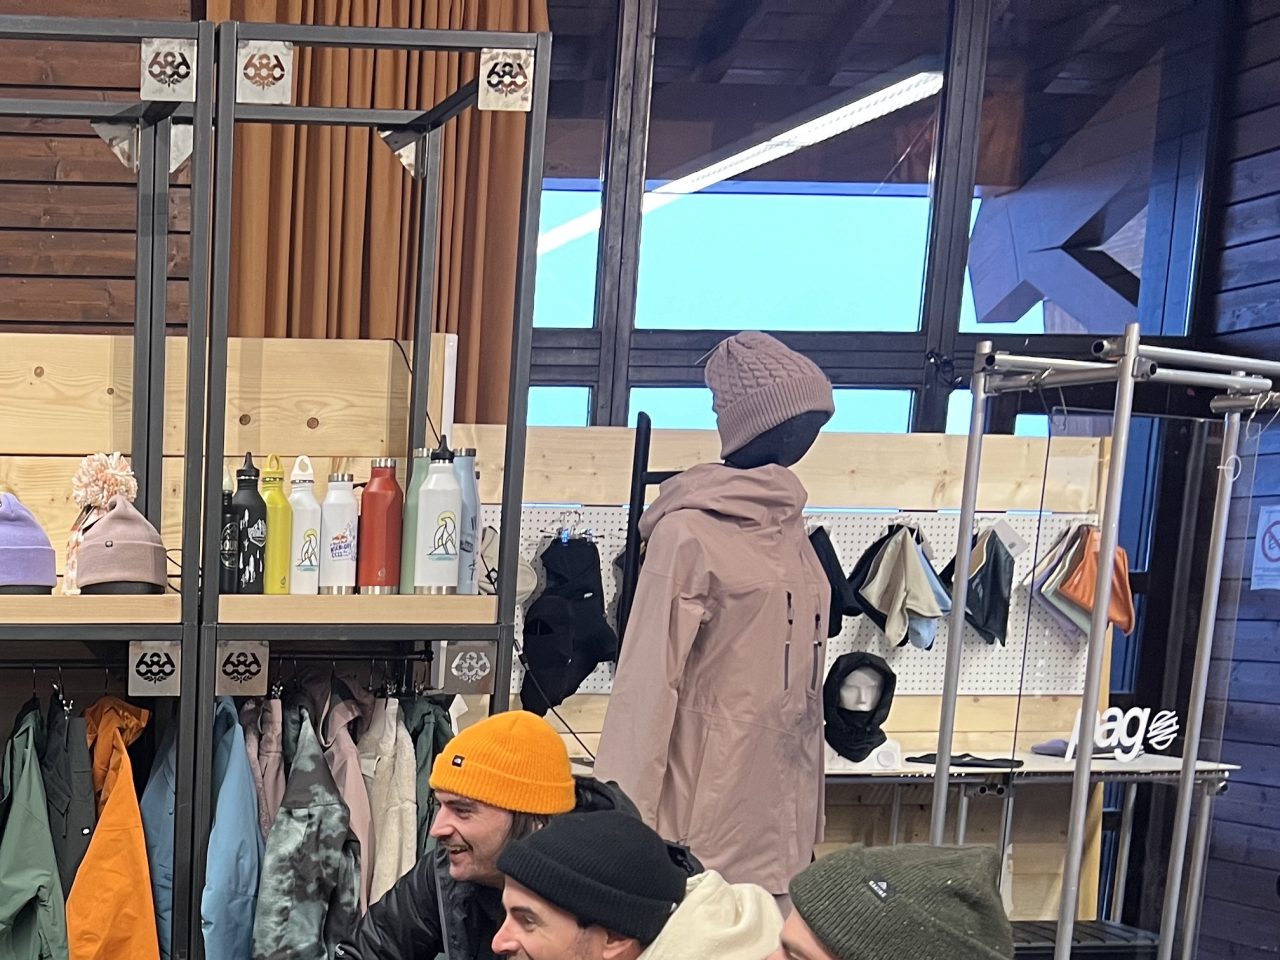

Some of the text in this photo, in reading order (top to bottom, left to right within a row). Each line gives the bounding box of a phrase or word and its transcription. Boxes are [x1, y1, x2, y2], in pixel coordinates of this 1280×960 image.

[148, 51, 190, 79] 686
[243, 52, 285, 80] 686
[486, 62, 528, 90] 686
[136, 652, 175, 676] 686
[222, 652, 261, 676] 686
[451, 651, 490, 675] 686
